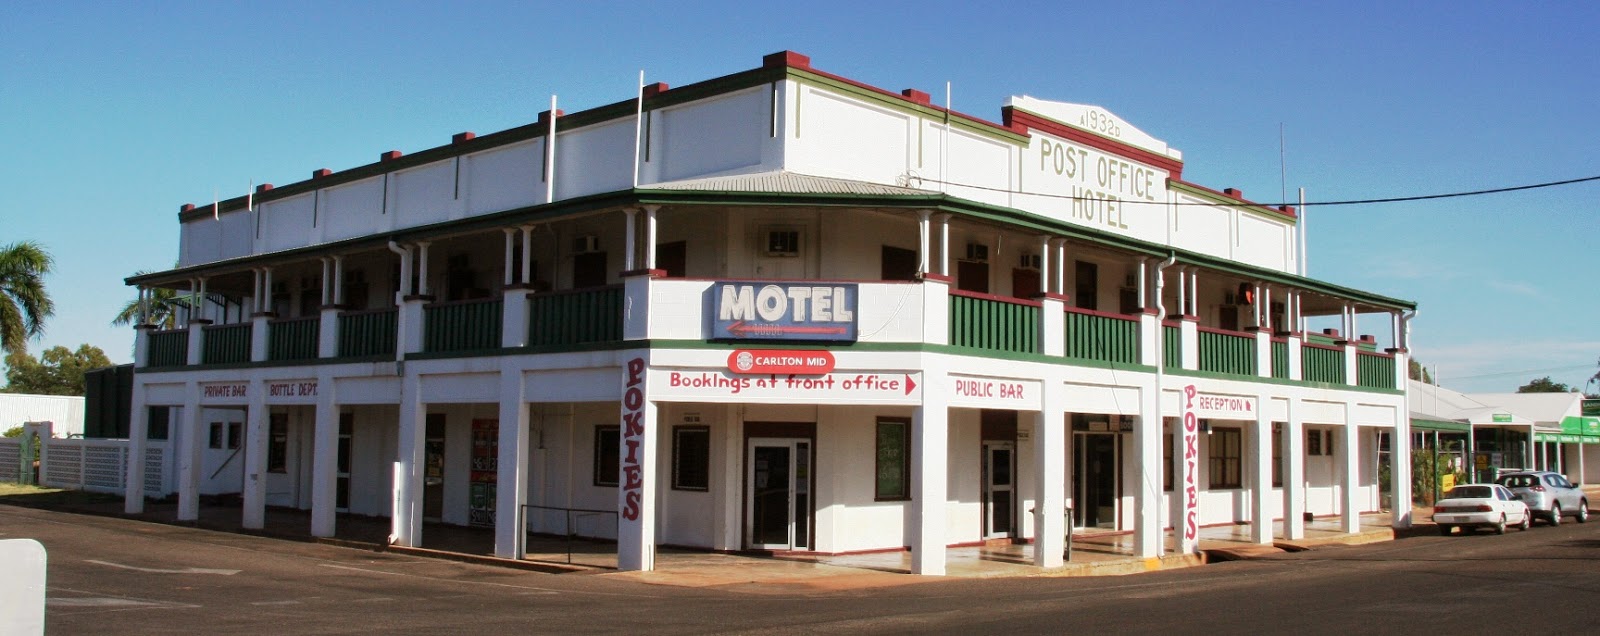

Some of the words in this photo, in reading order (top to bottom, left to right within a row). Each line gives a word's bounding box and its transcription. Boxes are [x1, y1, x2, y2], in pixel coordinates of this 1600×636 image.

[1041, 138, 1088, 182] POST
[1097, 156, 1154, 201] OFFICE
[1072, 185, 1128, 229] HOTEL
[719, 284, 852, 322] MOTEL
[755, 356, 803, 366] CARLTON
[807, 357, 826, 366] MID
[204, 385, 230, 397] PRIVATE
[232, 385, 247, 397] BAR
[270, 384, 295, 396] BOTTLE
[298, 383, 318, 396] DEPT.
[756, 374, 778, 388] at
[785, 374, 835, 390] front
[842, 375, 899, 390] office
[956, 380, 993, 397] PUBLIC
[1000, 383, 1024, 399] BAR
[1200, 396, 1243, 411] RECEPTION
[623, 357, 645, 521] POKIES
[1184, 384, 1197, 540] POKIES
